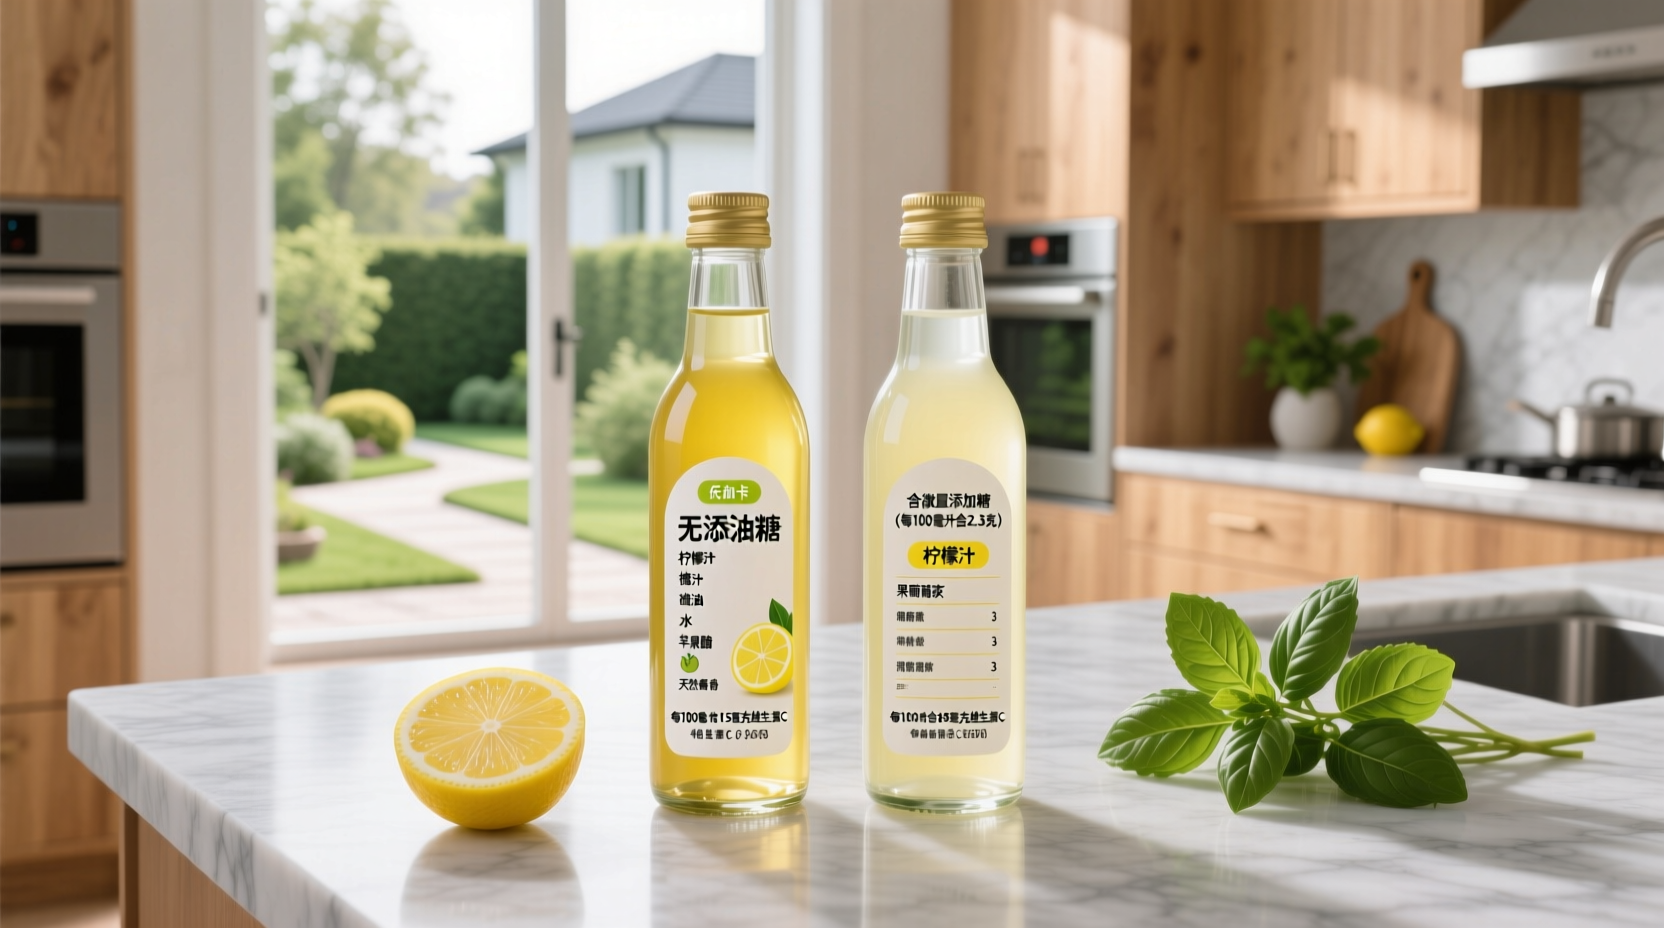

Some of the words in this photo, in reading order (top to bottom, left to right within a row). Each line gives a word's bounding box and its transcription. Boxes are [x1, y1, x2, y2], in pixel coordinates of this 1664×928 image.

[679, 613, 693, 628] 水
[990, 610, 998, 622] 3
[991, 636, 998, 647] 3
[990, 661, 998, 672] 3
